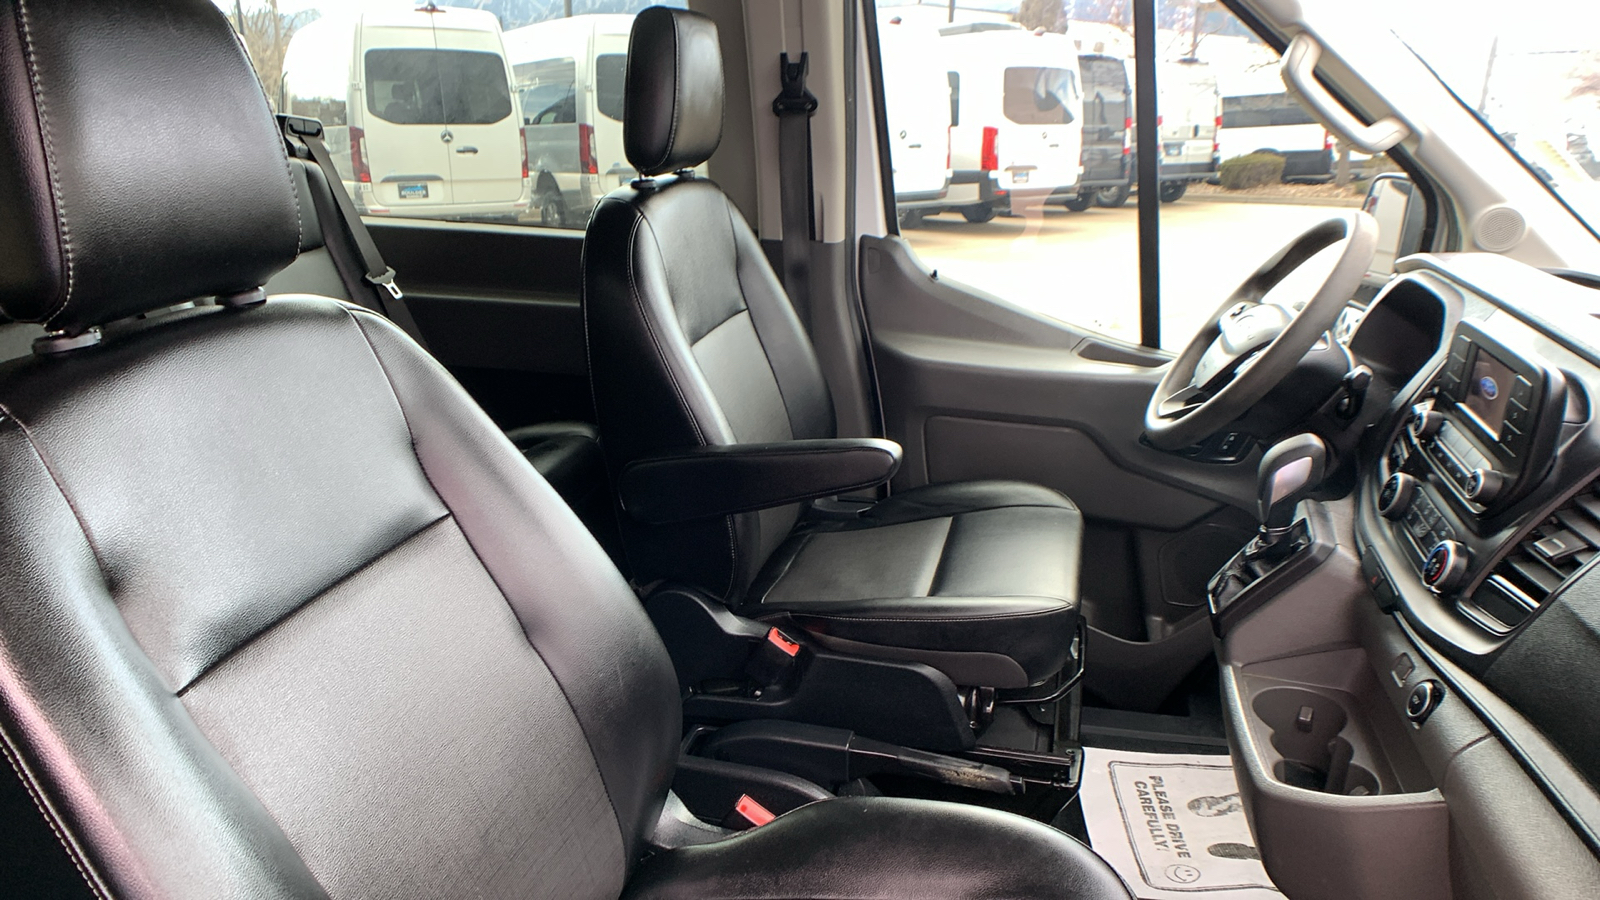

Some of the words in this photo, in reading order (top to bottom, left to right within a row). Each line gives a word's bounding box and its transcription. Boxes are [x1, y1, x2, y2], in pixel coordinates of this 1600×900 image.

[1134, 781, 1169, 851] CAREFULLY!
[1149, 775, 1175, 820] PLEASE
[1166, 823, 1191, 858] DRIVE
